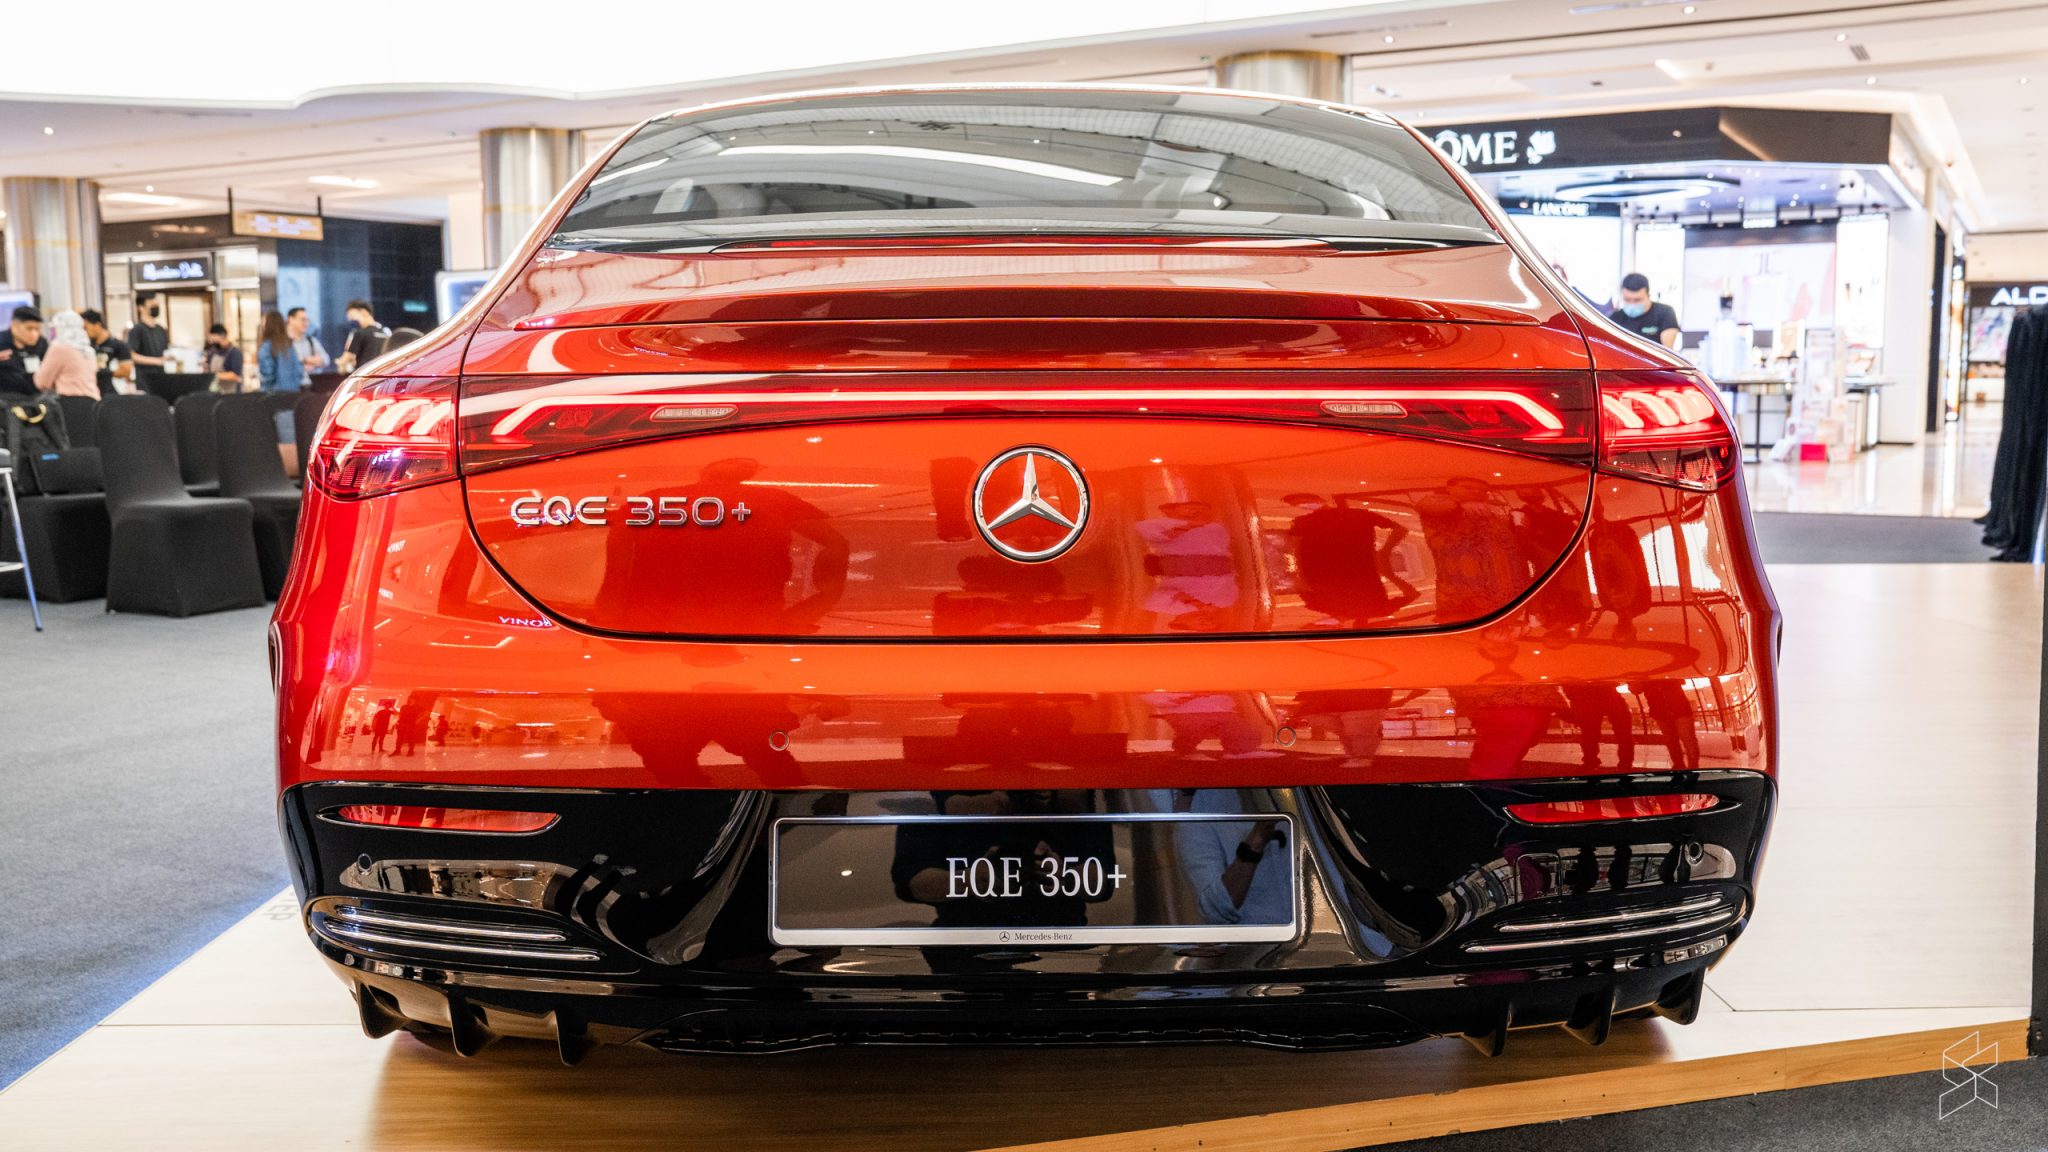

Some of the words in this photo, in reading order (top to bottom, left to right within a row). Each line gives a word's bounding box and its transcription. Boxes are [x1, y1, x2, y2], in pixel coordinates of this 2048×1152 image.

[1432, 129, 1518, 167] ÔME
[510, 495, 609, 526] EQE
[625, 496, 751, 527] 350+
[945, 856, 1023, 898] EQE
[1039, 856, 1127, 897] 350+
[1014, 932, 1073, 941] Mercedes-Benz
